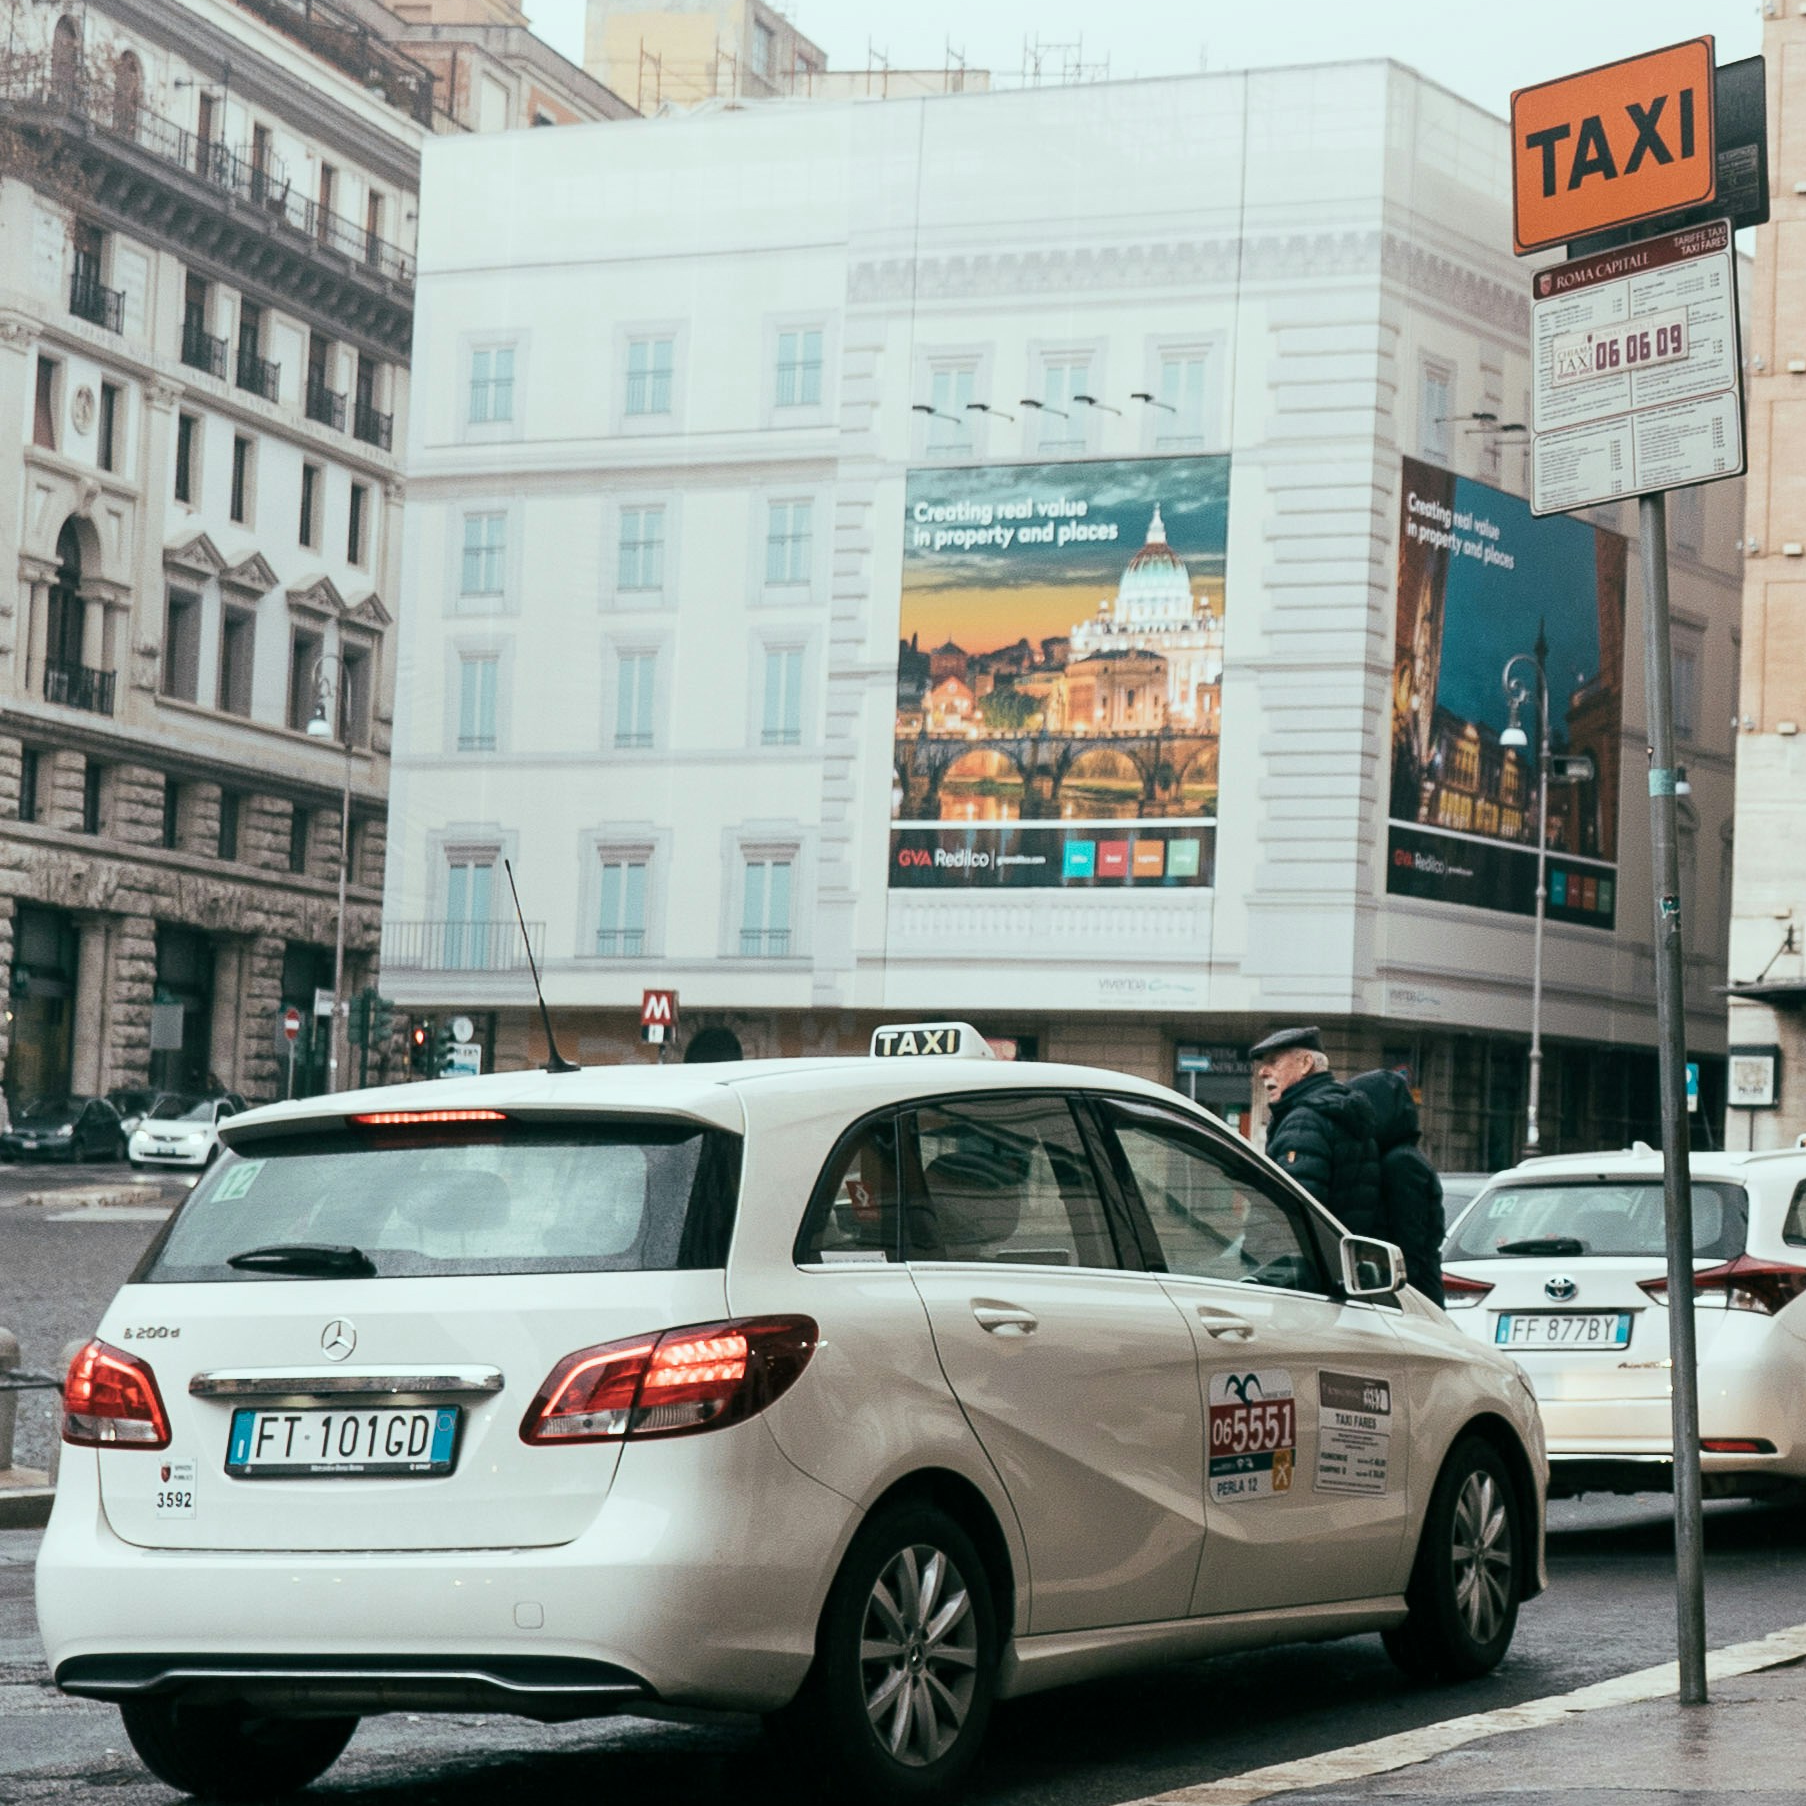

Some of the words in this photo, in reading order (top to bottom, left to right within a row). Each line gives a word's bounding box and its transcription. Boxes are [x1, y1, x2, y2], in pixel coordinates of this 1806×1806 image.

[1526, 88, 1694, 198] TAXI
[1673, 229, 1706, 248] TARIFFE
[1708, 225, 1726, 239] TAXI
[1681, 242, 1699, 256] TAXI
[1701, 236, 1727, 251] FARES
[1556, 267, 1594, 289] ROMA
[1595, 252, 1650, 278] CAPITALE
[1596, 339, 1620, 370] 06
[1626, 332, 1650, 363] 06
[1657, 324, 1682, 357] 09
[1558, 353, 1593, 374] TAXI
[914, 500, 993, 525] Creating
[997, 497, 1032, 519] real
[1037, 497, 1088, 517] value
[1408, 492, 1452, 529] Creating
[1453, 512, 1472, 530] real
[1474, 519, 1500, 541] value
[913, 527, 930, 546] in
[935, 525, 1015, 551] property
[1017, 521, 1054, 543] and
[1058, 520, 1118, 547] places
[1407, 515, 1418, 538] in
[1419, 526, 1462, 557] property
[1463, 540, 1483, 558] and
[1484, 544, 1514, 569] places
[898, 849, 932, 867] GVA
[934, 845, 989, 867] Redilco
[644, 994, 671, 1019] M
[878, 1030, 955, 1056] TAXI
[222, 1165, 258, 1197] 12
[1496, 1196, 1516, 1216] 12
[136, 1326, 170, 1340] 200
[1512, 1318, 1538, 1342] FF
[1546, 1318, 1616, 1342] 877BY
[1336, 1413, 1352, 1426] TAXI
[1354, 1414, 1377, 1430] FARES
[256, 1416, 302, 1458] FT
[321, 1415, 430, 1458] 101GD
[1217, 1479, 1245, 1496] PERLA
[1248, 1477, 1258, 1492] 12
[157, 1492, 192, 1508] 3592
